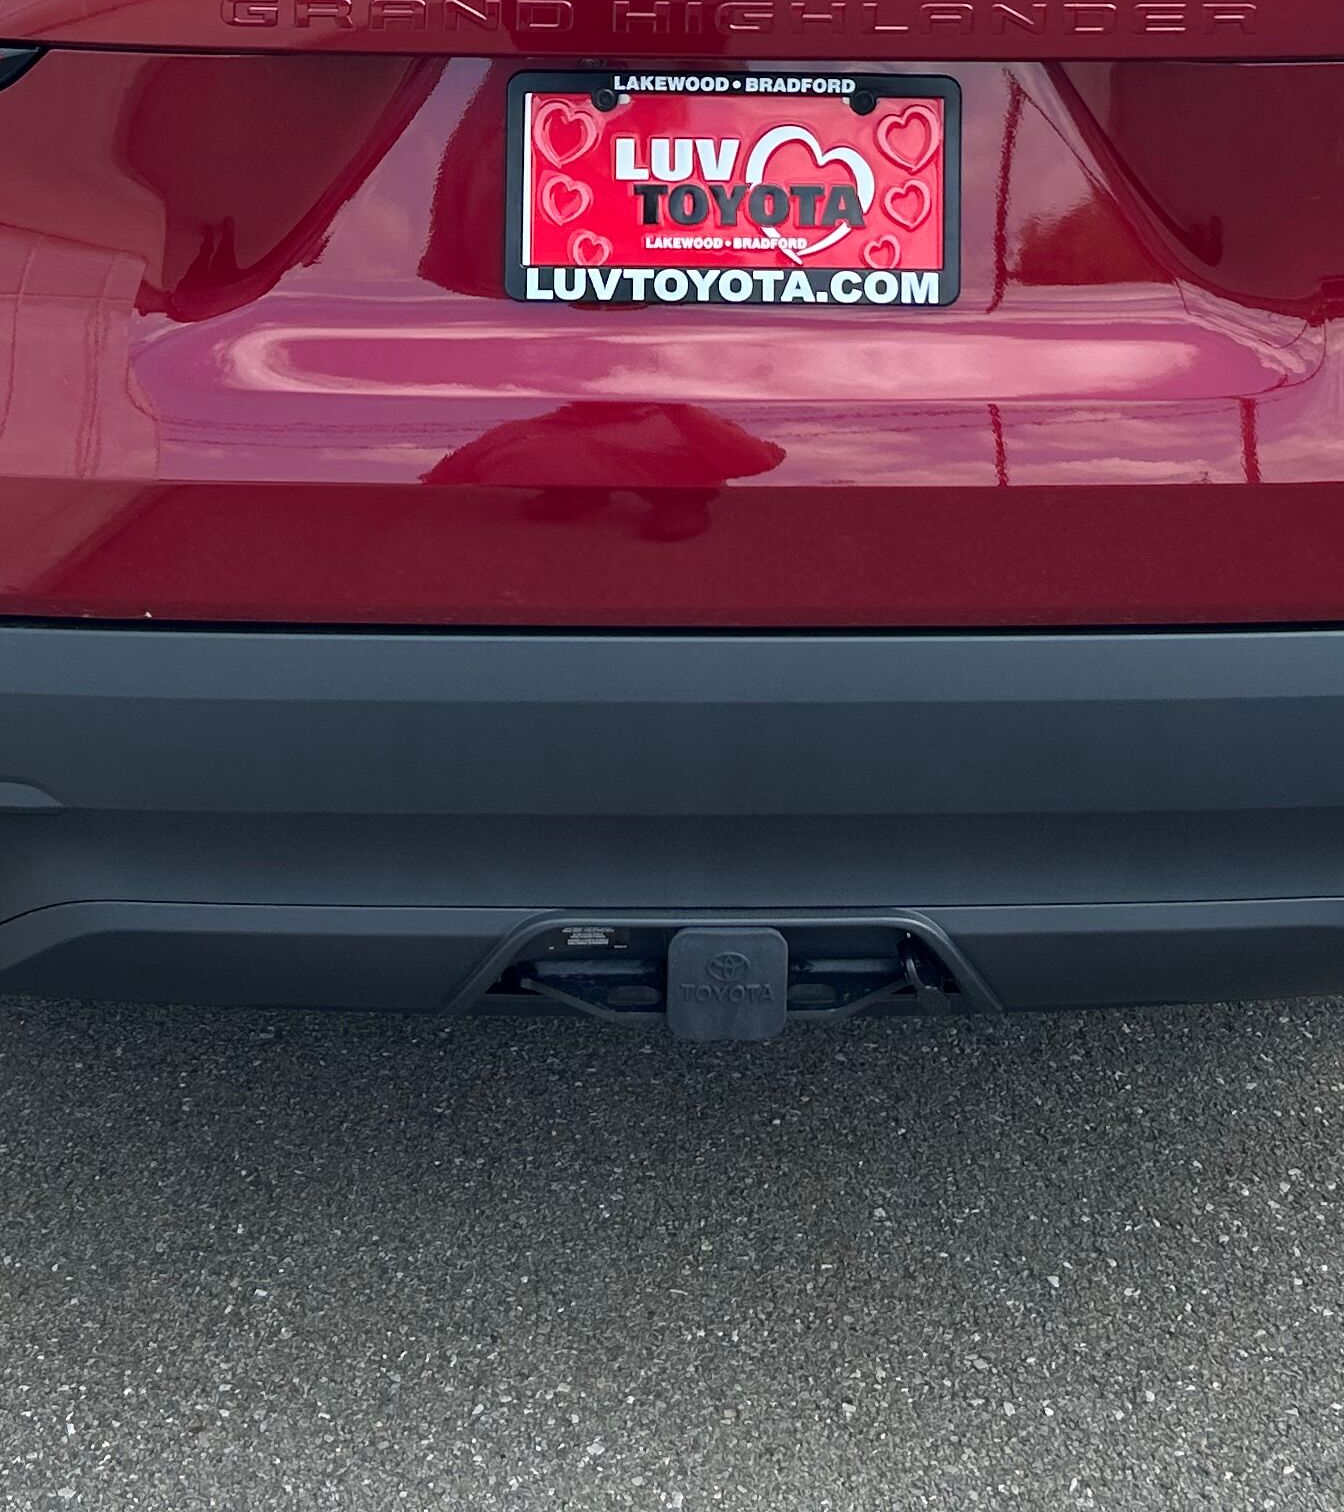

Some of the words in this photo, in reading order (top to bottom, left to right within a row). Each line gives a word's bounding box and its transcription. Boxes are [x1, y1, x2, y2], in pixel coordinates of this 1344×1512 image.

[613, 75, 729, 93] LAKEWOOD
[745, 77, 856, 94] BRADFORD
[615, 137, 740, 182] LUV
[633, 183, 864, 227] TOYOTA
[645, 236, 723, 250] LAKEWOOD
[733, 237, 807, 250] BRADFORD
[525, 267, 940, 304] LUVTOYOTA.COM
[680, 983, 776, 1002] TOYOTA
